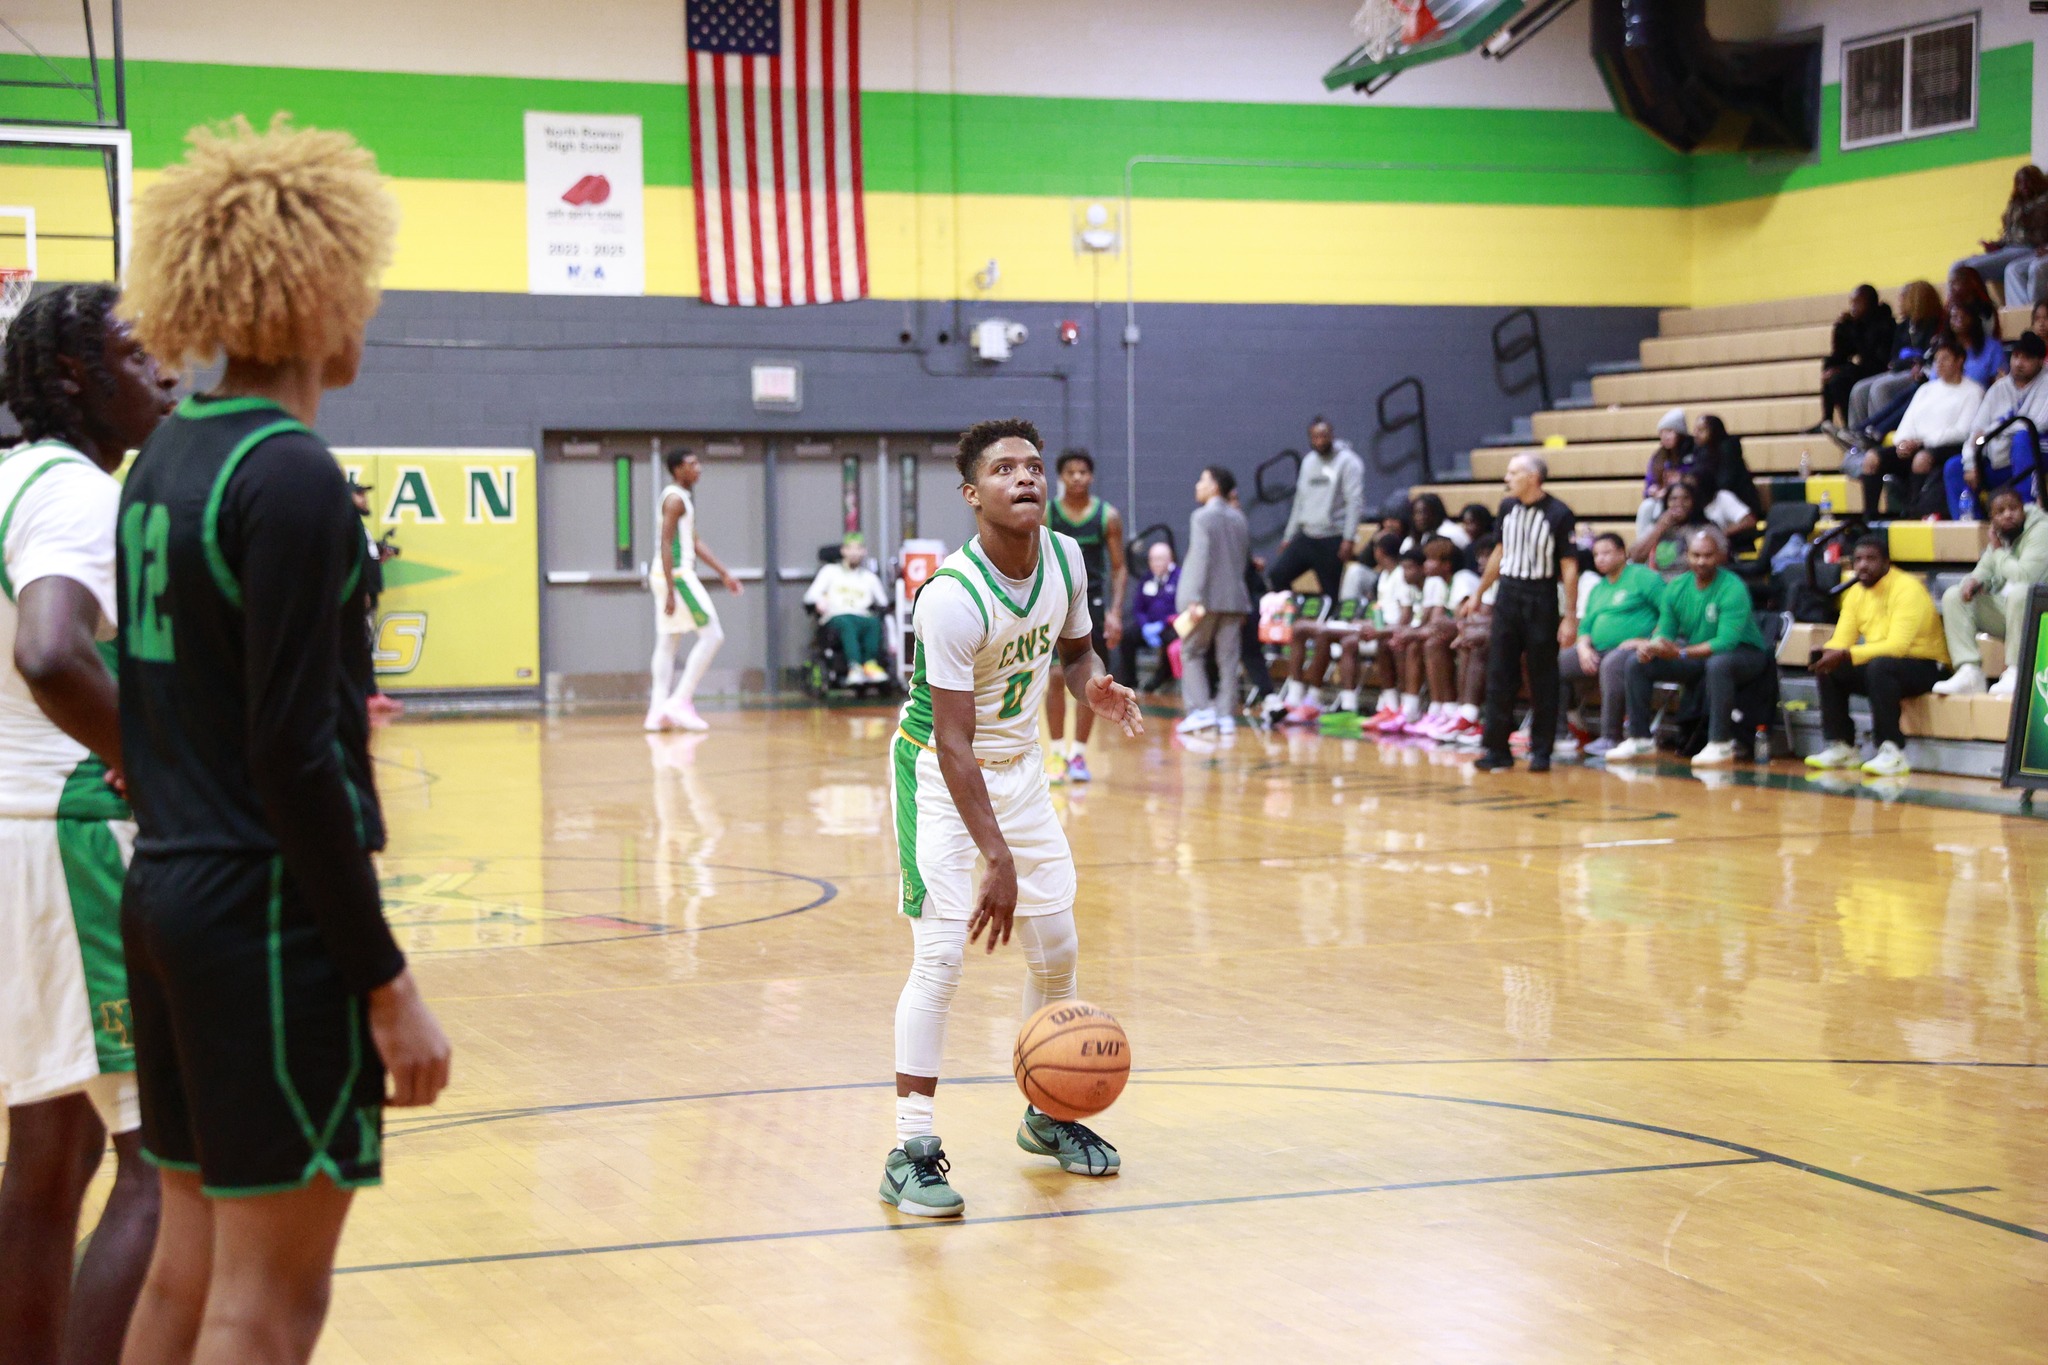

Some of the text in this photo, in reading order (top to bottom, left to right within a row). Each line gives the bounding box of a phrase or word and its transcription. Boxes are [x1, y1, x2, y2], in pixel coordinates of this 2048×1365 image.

[546, 140, 622, 154] High School
[548, 243, 580, 256] 2022
[344, 465, 518, 524] AN
[121, 502, 176, 663] 12
[998, 623, 1051, 670] CAVS
